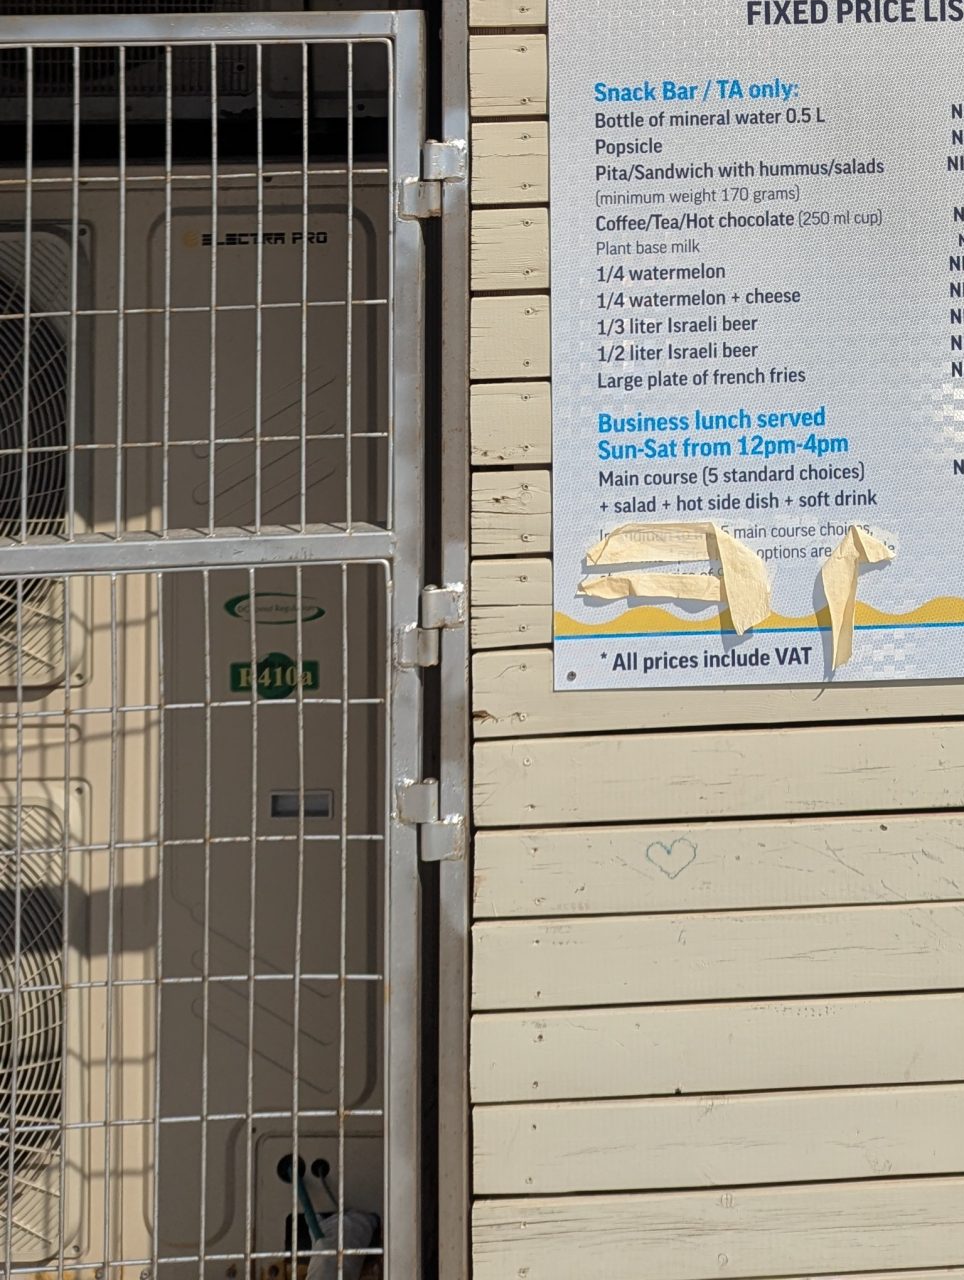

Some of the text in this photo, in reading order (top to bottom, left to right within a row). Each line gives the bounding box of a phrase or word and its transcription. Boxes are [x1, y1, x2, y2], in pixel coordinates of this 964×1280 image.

[594, 81, 656, 103] Snack
[662, 81, 697, 100] Bar
[717, 80, 744, 99] TA
[749, 78, 799, 101] only:
[595, 108, 826, 129] Bottle of mineral water 0.5 L
[595, 138, 663, 158] Popsicle
[596, 158, 884, 181] Pita/Sandwich with hummus/salads
[595, 185, 800, 207] (minimum weight 170 grams)
[596, 210, 883, 231] Coffee/Tea/Hot chocolate (250 ml cup)
[596, 239, 700, 256] Plant base milk
[597, 263, 726, 283] 1/4 watermelon
[597, 288, 801, 309] 1/4 watermelon + cheese
[597, 366, 806, 391] Large plate of french fries
[598, 406, 826, 433] Business lunch served
[598, 434, 849, 460] Sun-Sat from 12pm-4pm
[756, 543, 832, 560] options are
[612, 651, 638, 671] All
[643, 649, 699, 673] prices
[703, 648, 771, 668] include
[775, 647, 812, 665] VAT
